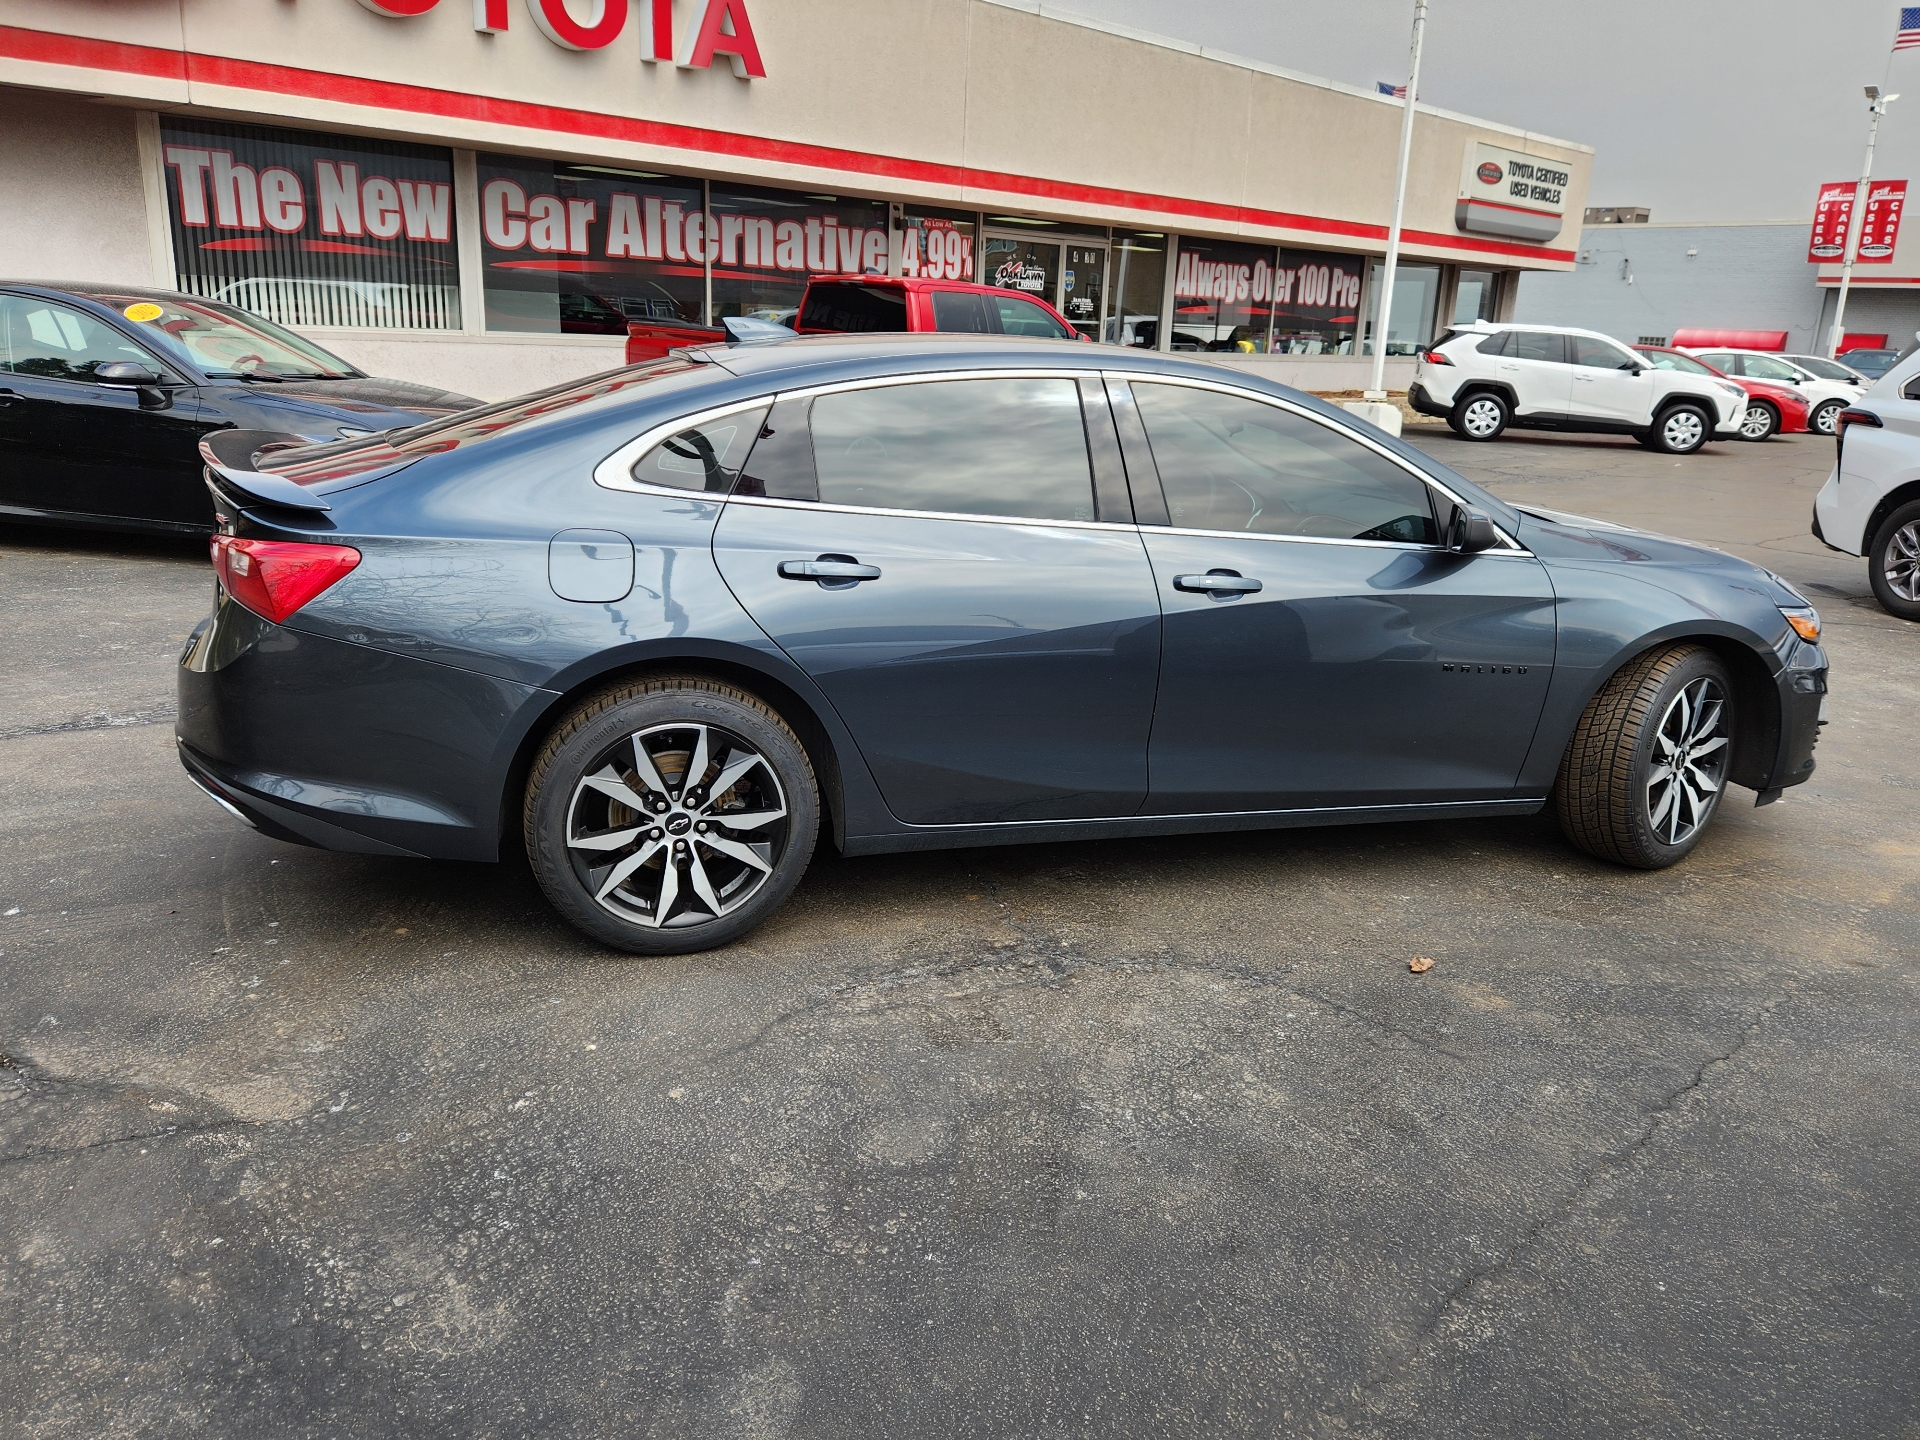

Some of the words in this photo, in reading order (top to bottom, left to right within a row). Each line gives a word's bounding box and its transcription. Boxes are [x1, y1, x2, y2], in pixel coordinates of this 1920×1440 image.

[163, 145, 306, 233] The
[314, 159, 451, 242] New
[1508, 160, 1534, 180] TOYOTA
[1535, 167, 1568, 187] CERTIFIED
[1510, 181, 1529, 198] USED
[1530, 185, 1561, 204] VEHICLES
[481, 178, 596, 256] Car
[605, 192, 888, 276] Alternative
[1813, 203, 1829, 244] USED
[1834, 203, 1850, 244] CARS
[1862, 202, 1879, 244] USED
[1883, 202, 1900, 244] CARS
[902, 227, 973, 280] 4.99%
[1020, 281, 1041, 289] TOYOTA
[1175, 250, 1250, 304] Always
[1252, 258, 1296, 304] Over
[1297, 263, 1329, 307] 100
[1330, 266, 1360, 309] Pre
[1442, 664, 1528, 675] MALIBU
[570, 721, 618, 765] Continental
